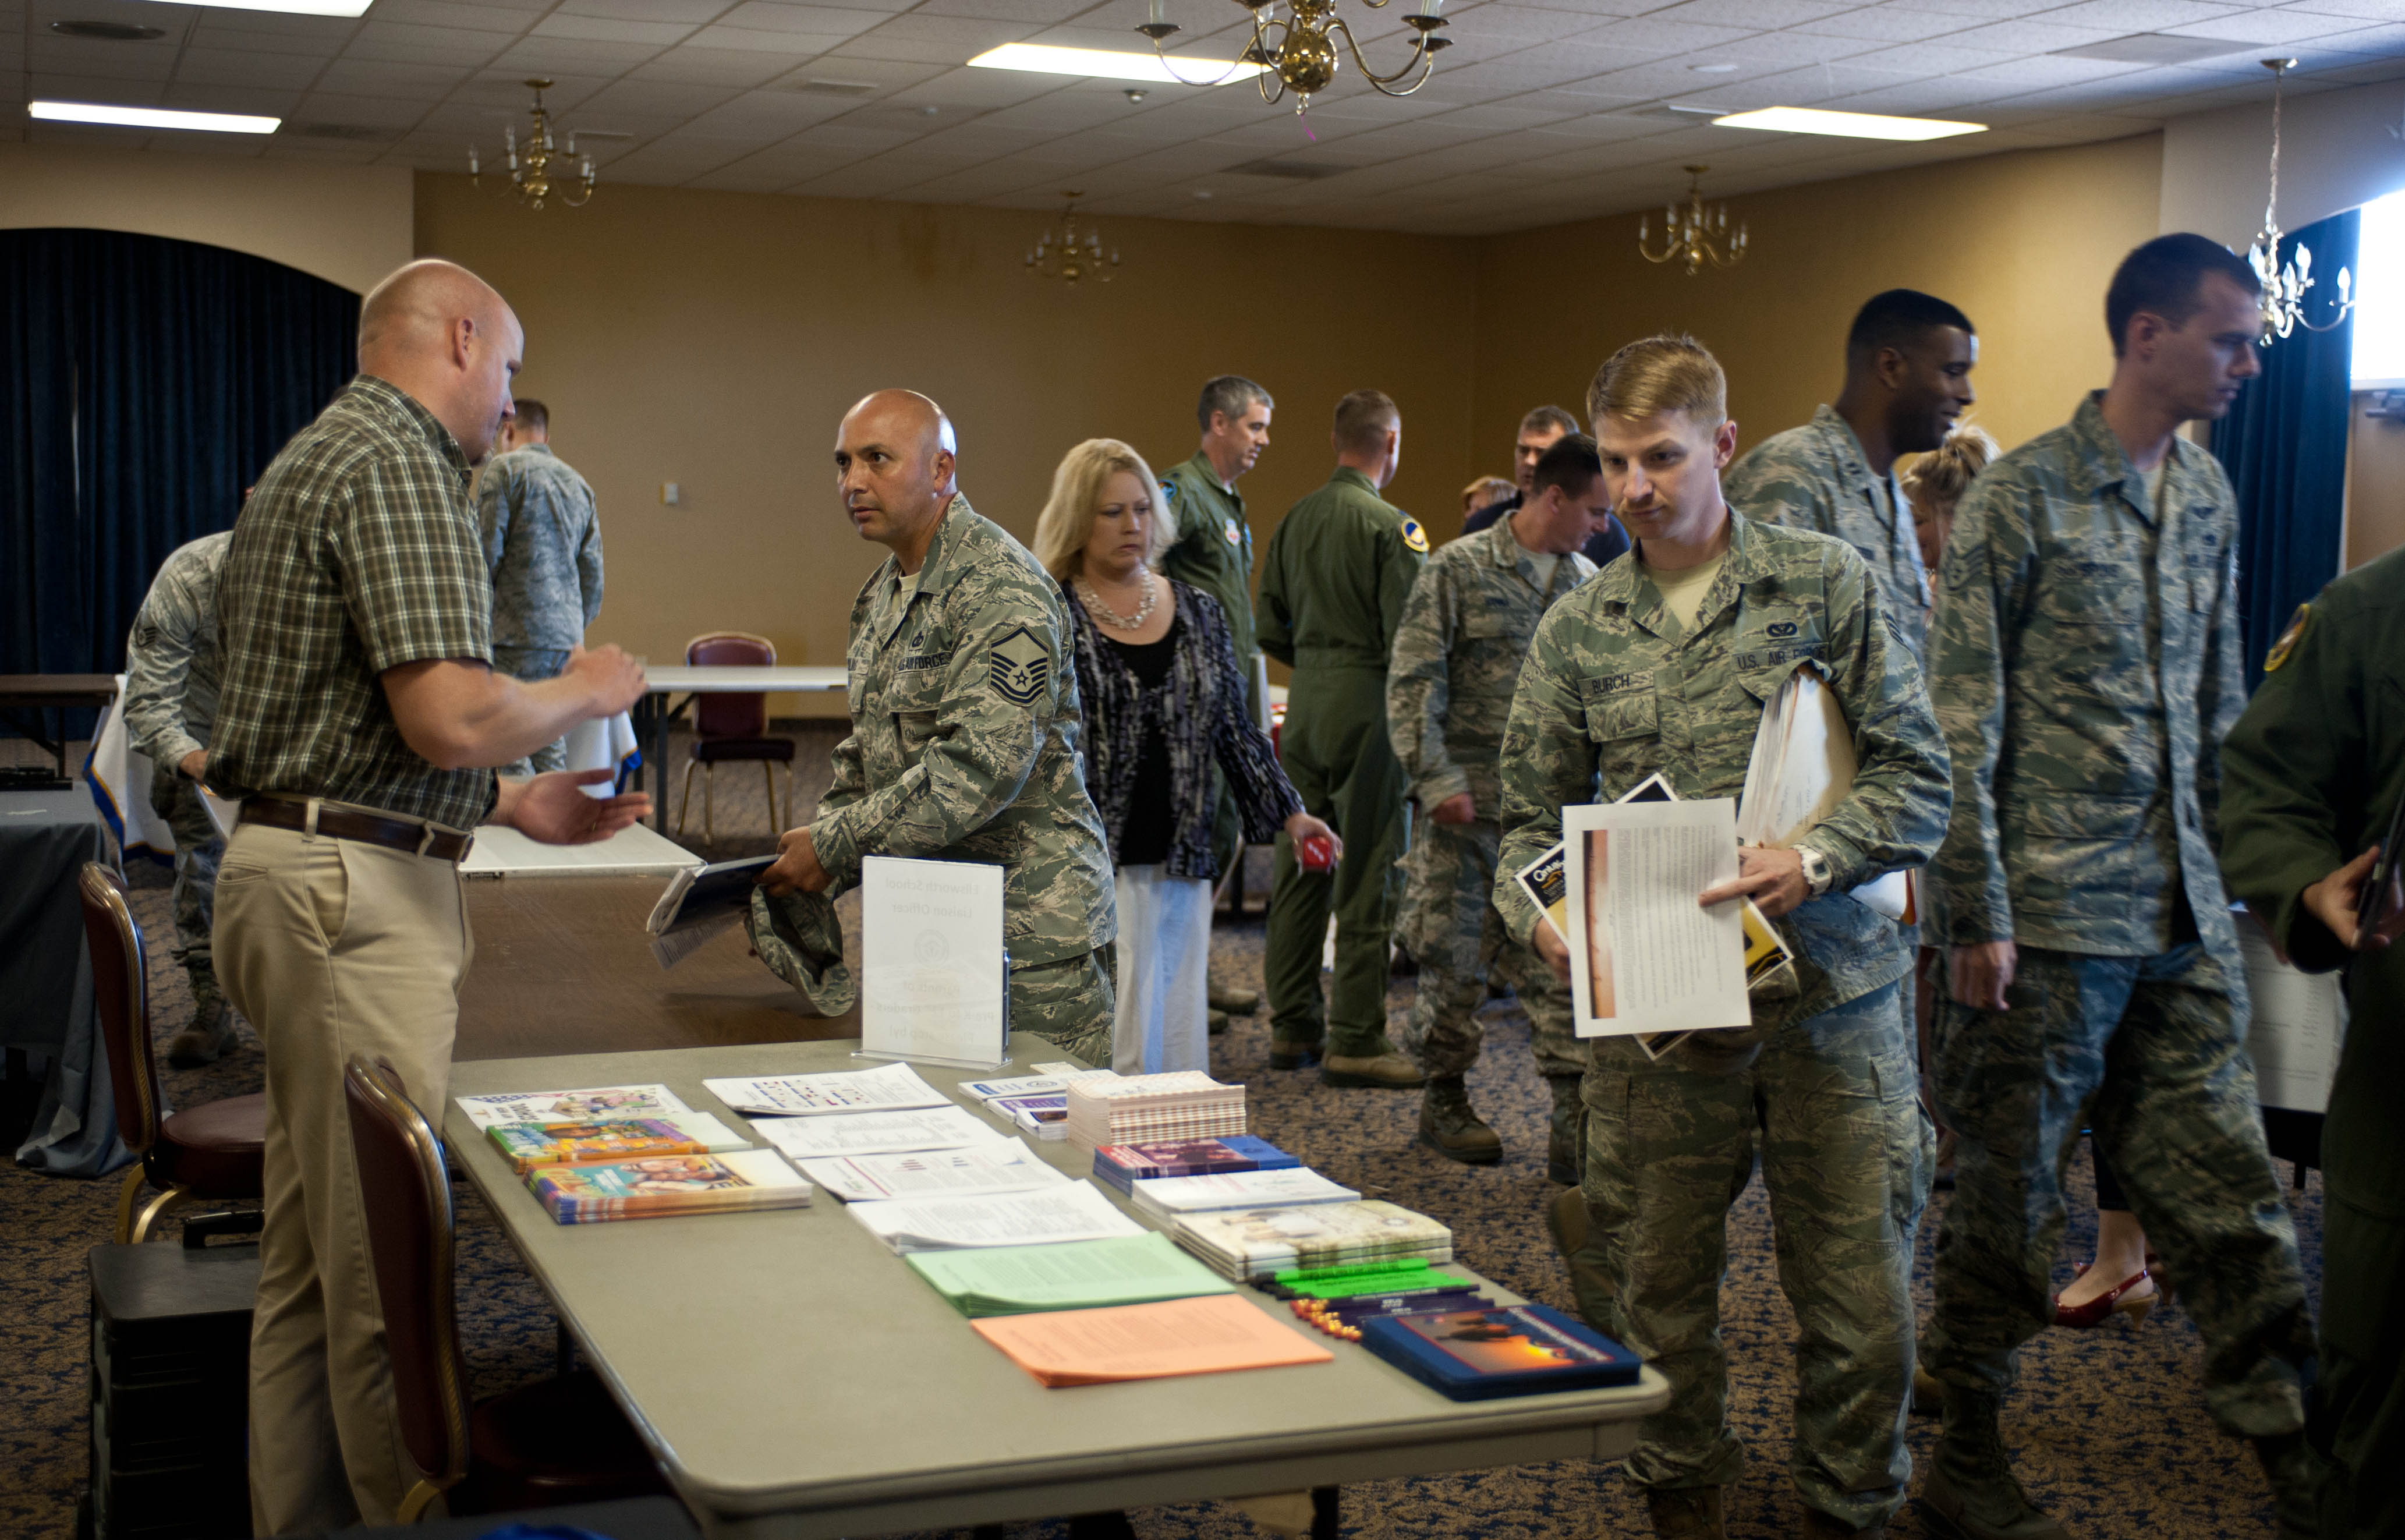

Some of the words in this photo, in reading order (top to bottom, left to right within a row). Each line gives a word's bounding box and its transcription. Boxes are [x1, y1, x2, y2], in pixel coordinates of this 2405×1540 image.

[915, 653, 946, 670] FORCE
[1738, 654, 1759, 670] U.S.
[1768, 650, 1786, 666] AIR
[1592, 674, 1630, 693] BURCH
